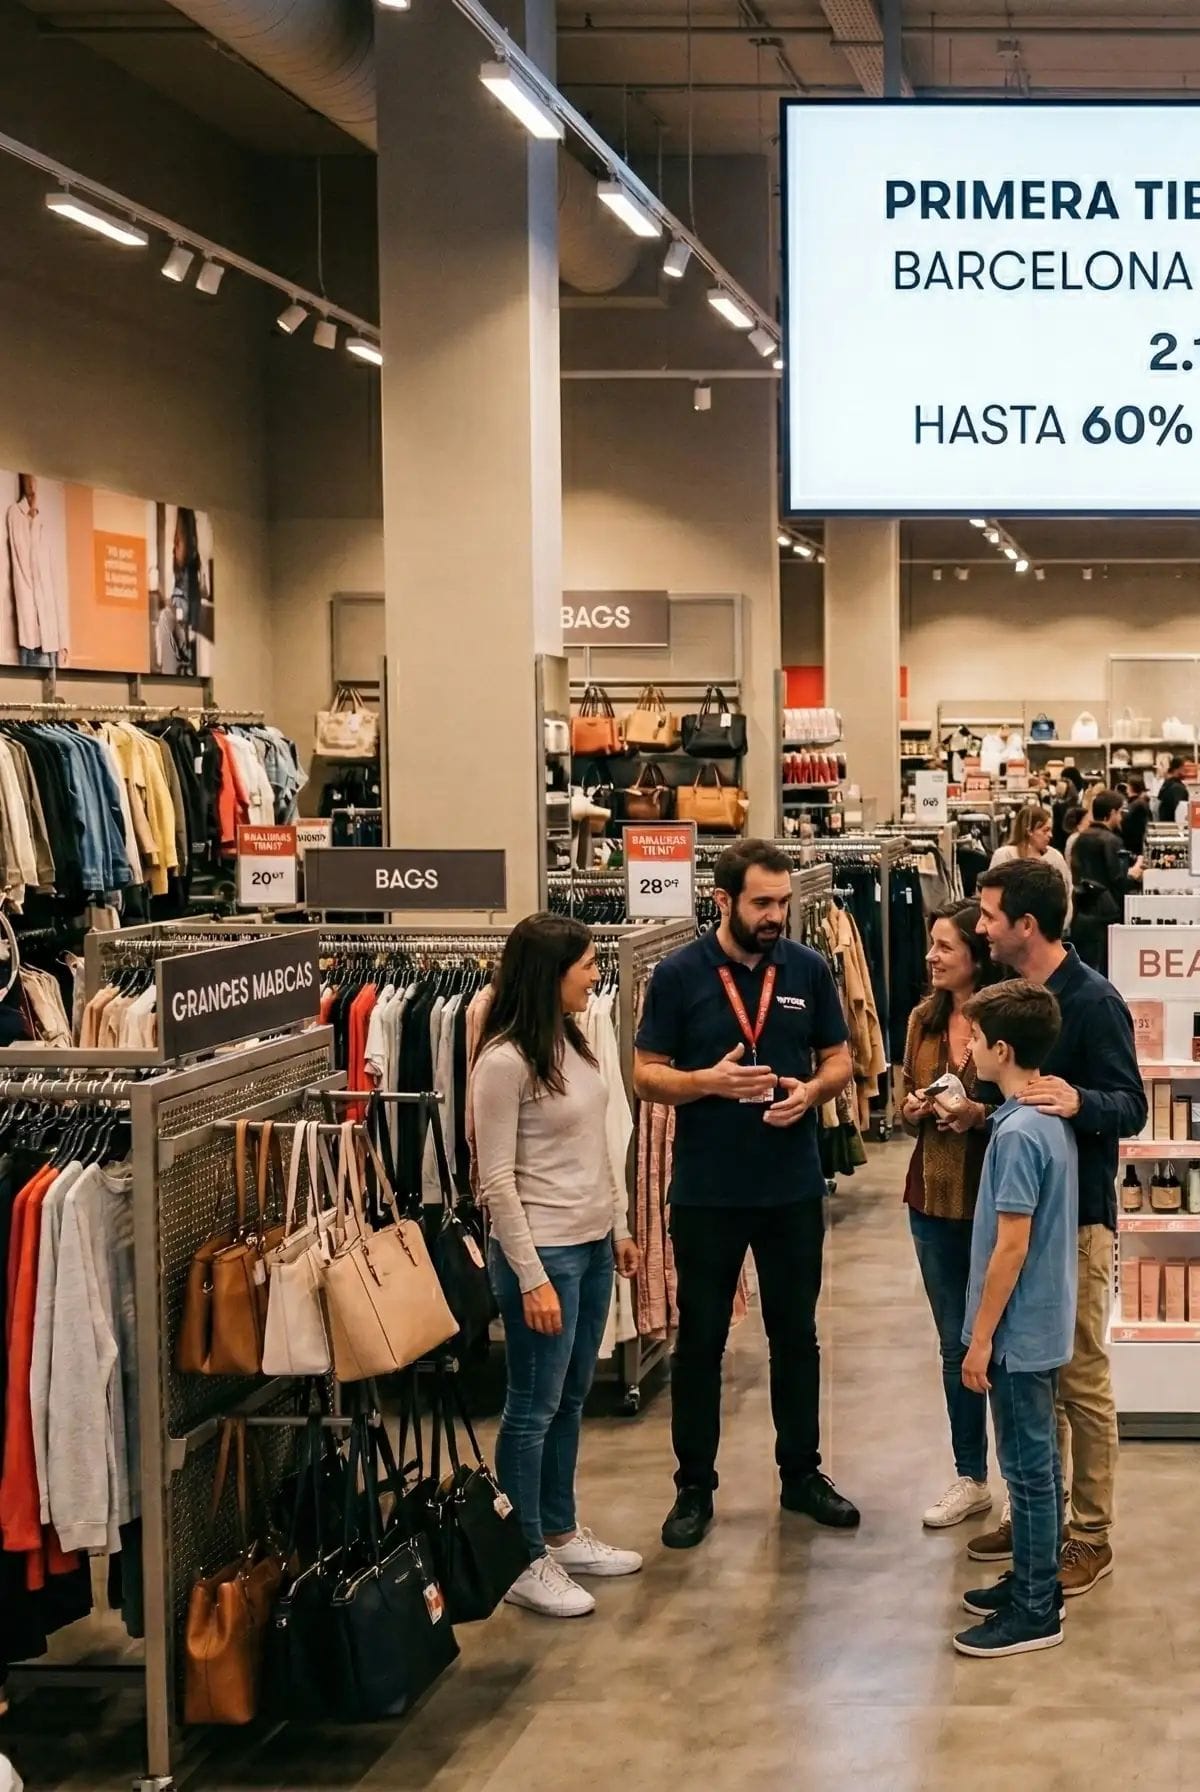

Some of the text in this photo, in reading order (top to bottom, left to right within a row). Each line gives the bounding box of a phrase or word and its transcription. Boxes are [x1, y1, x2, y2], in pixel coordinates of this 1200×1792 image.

[886, 180, 1119, 220] PRIMERA
[894, 250, 1193, 291] BARCELONA
[915, 404, 1066, 445] HASTA
[1081, 404, 1193, 446] 60%
[560, 606, 631, 629] BAGS
[375, 868, 439, 890] BAGS
